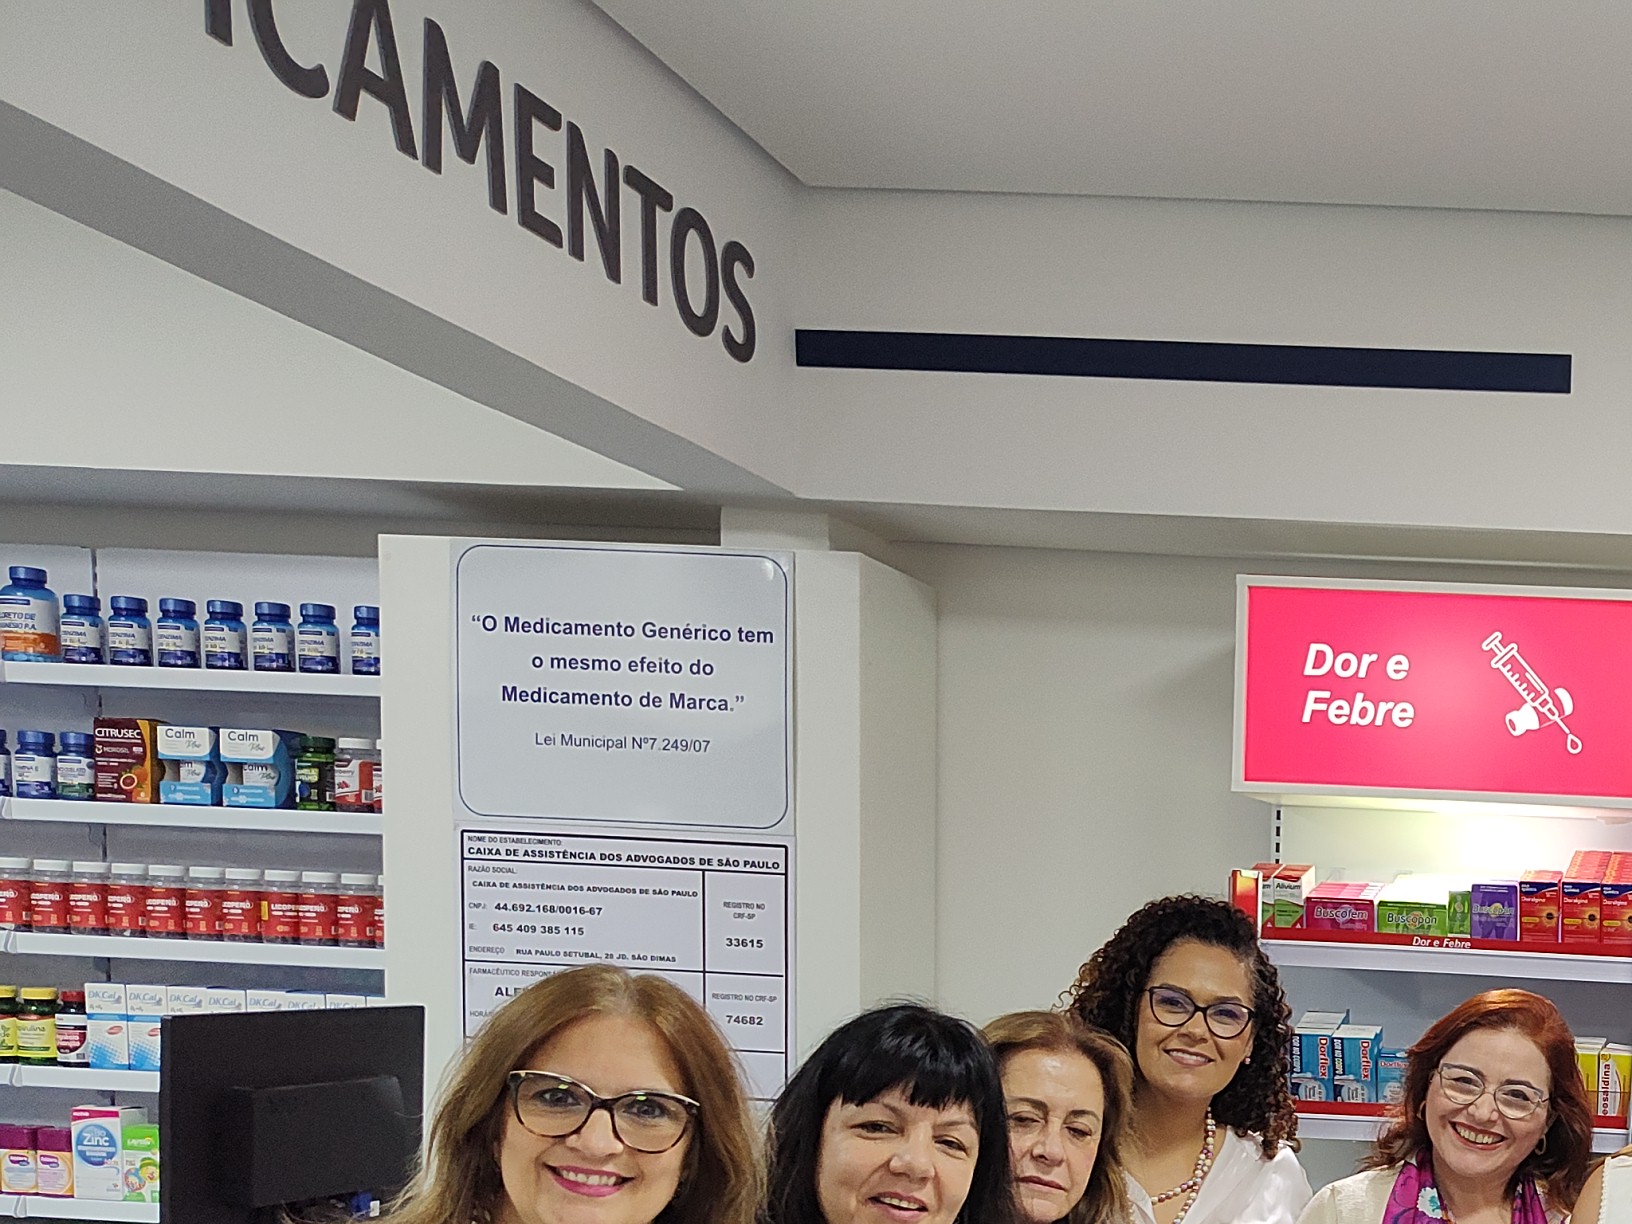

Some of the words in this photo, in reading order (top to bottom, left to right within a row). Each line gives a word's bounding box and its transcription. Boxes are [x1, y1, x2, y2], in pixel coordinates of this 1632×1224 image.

[504, 616, 636, 638] Medicamento
[641, 622, 731, 642] Genérico
[738, 626, 774, 643] tem
[532, 655, 543, 669] o
[550, 656, 621, 672] mesmo
[628, 656, 683, 675] efeito
[689, 660, 714, 676] do
[1302, 643, 1377, 680] Dor
[1386, 654, 1409, 680] e
[501, 685, 633, 707] Medicamento
[639, 692, 663, 708] de
[1301, 690, 1415, 728] Febre
[95, 728, 141, 738] CITRUSEC
[165, 728, 195, 740] Calm
[227, 731, 259, 743] Calm
[535, 732, 556, 746] Lei
[560, 733, 627, 751] Municipal
[468, 847, 502, 856] CAIXA
[505, 849, 519, 857] DE
[523, 849, 596, 861] ASSISTÊNCIA
[600, 853, 623, 862] DOS
[626, 854, 695, 866] ADVOGADOS
[700, 857, 714, 867] DE
[717, 857, 740, 868] SÃO
[743, 859, 780, 870] PAULO
[468, 865, 490, 873] RAZÃO
[472, 880, 497, 888] CAIXA
[512, 882, 565, 891] ASSISTÊNCIA
[586, 886, 637, 895] ADVOGADOS
[652, 888, 669, 896] SÃO
[1276, 882, 1301, 891] Alivium
[494, 902, 603, 916] 44.692.168/0016-67
[723, 901, 754, 909] REGISTRO
[1314, 907, 1368, 920] Buscofem
[1387, 912, 1437, 925] Buscopan
[493, 923, 513, 933] 645
[516, 924, 537, 934] 409
[540, 925, 560, 935] 385
[564, 926, 585, 936] 115
[725, 938, 763, 948] 33615
[1412, 937, 1431, 947] Dor
[1442, 938, 1471, 949] Febre
[516, 948, 533, 956] RUA
[535, 949, 561, 957] PAULO
[631, 953, 648, 962] SÃO
[650, 954, 676, 963] DIMAS
[469, 967, 520, 976] FARMACÊUTICO
[711, 993, 743, 1001] REGISTRO
[744, 994, 754, 1002] NO
[725, 1015, 763, 1026] 74682
[1318, 1037, 1329, 1079] Dorflex
[1360, 1040, 1372, 1080] Dorflex
[83, 1132, 110, 1146] Zinc
